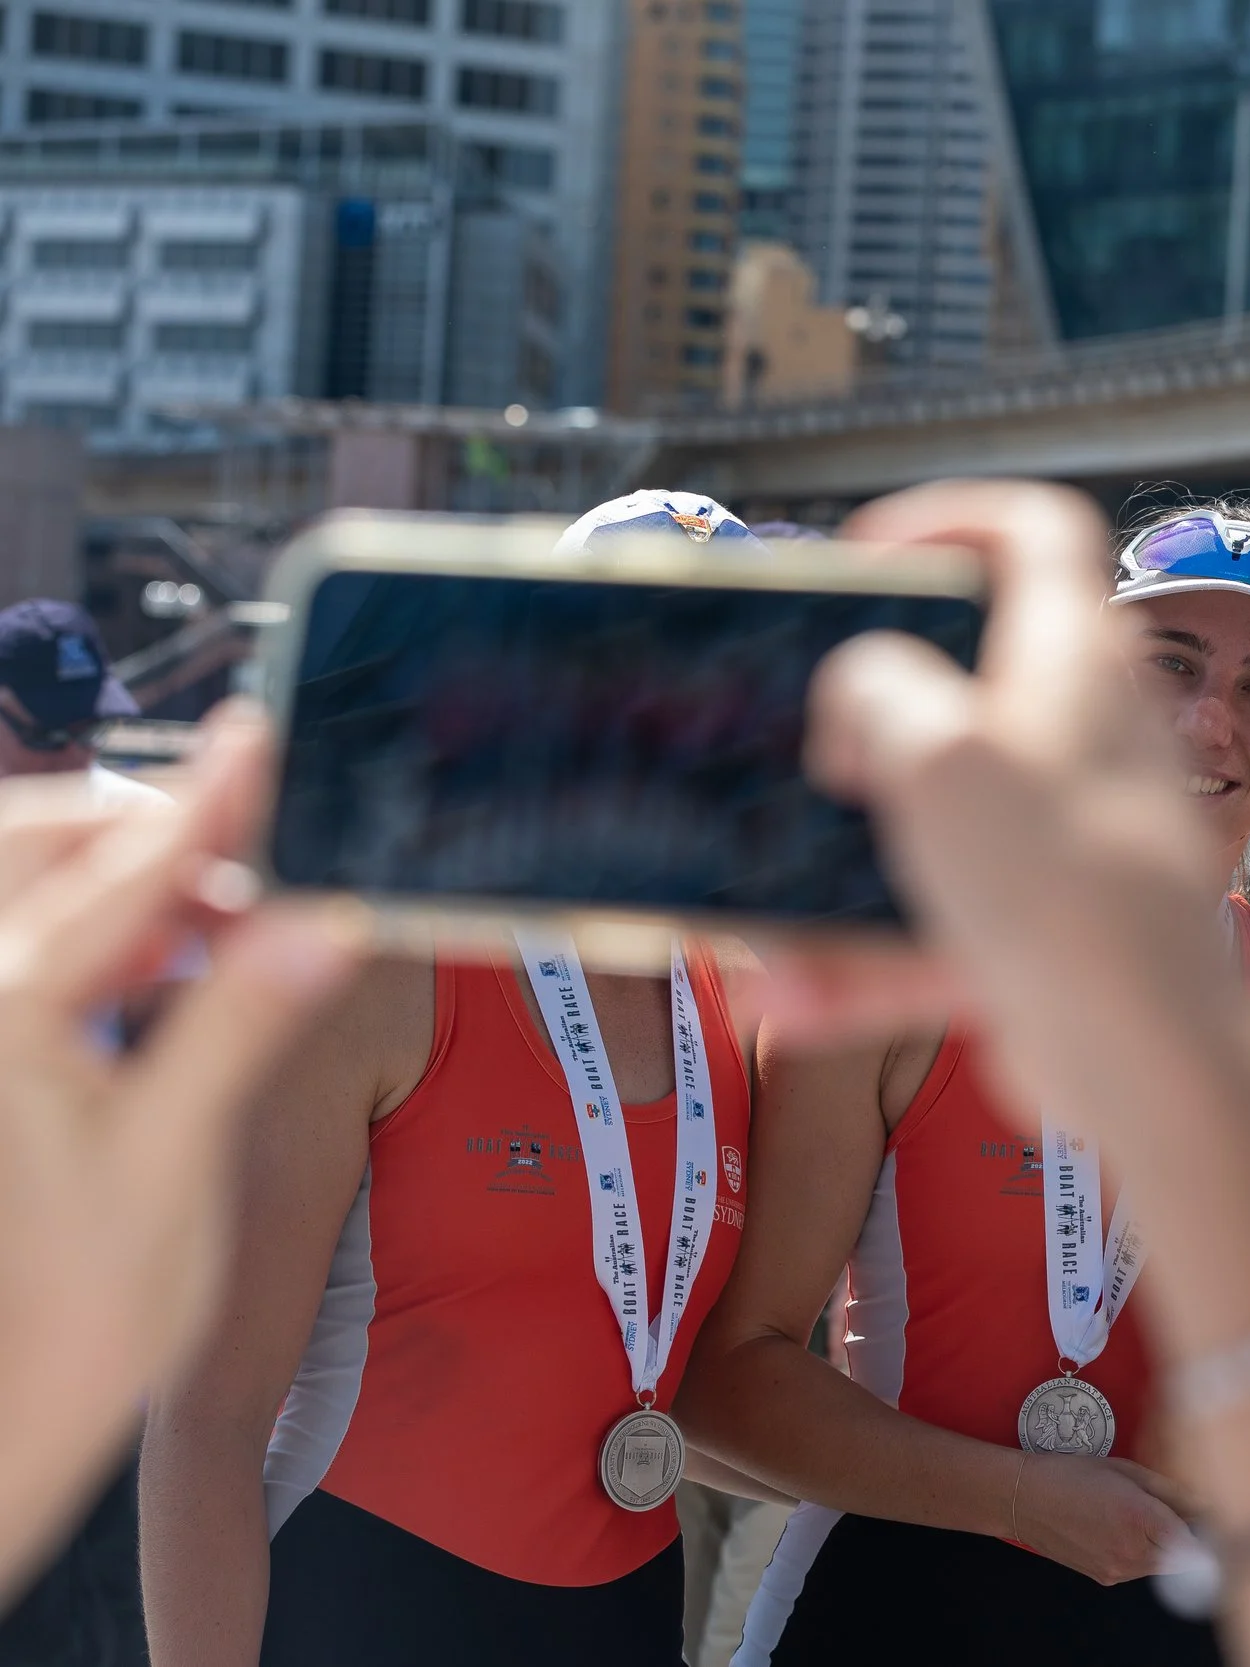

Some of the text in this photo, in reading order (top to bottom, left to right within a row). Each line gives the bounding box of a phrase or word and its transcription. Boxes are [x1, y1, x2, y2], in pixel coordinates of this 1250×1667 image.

[559, 986, 580, 1017] RACE
[676, 988, 686, 1021] BOAT
[683, 1058, 696, 1090] RACE
[582, 1059, 604, 1090] BOAT
[602, 1096, 614, 1126] SYDNEY
[466, 1138, 502, 1154] BOAT
[980, 1140, 1016, 1158] BOAT
[613, 1204, 630, 1236] RACE
[1059, 1166, 1078, 1274] BOAT RACE
[609, 1234, 620, 1284] The Australian
[674, 1197, 696, 1308] BOAT RACE
[622, 1282, 637, 1315] BOAT
[1111, 1267, 1127, 1302] BOAT
[628, 1321, 638, 1352] SYDNEY
[1022, 1378, 1112, 1420] AUSTRALIAN BOAT RACE
